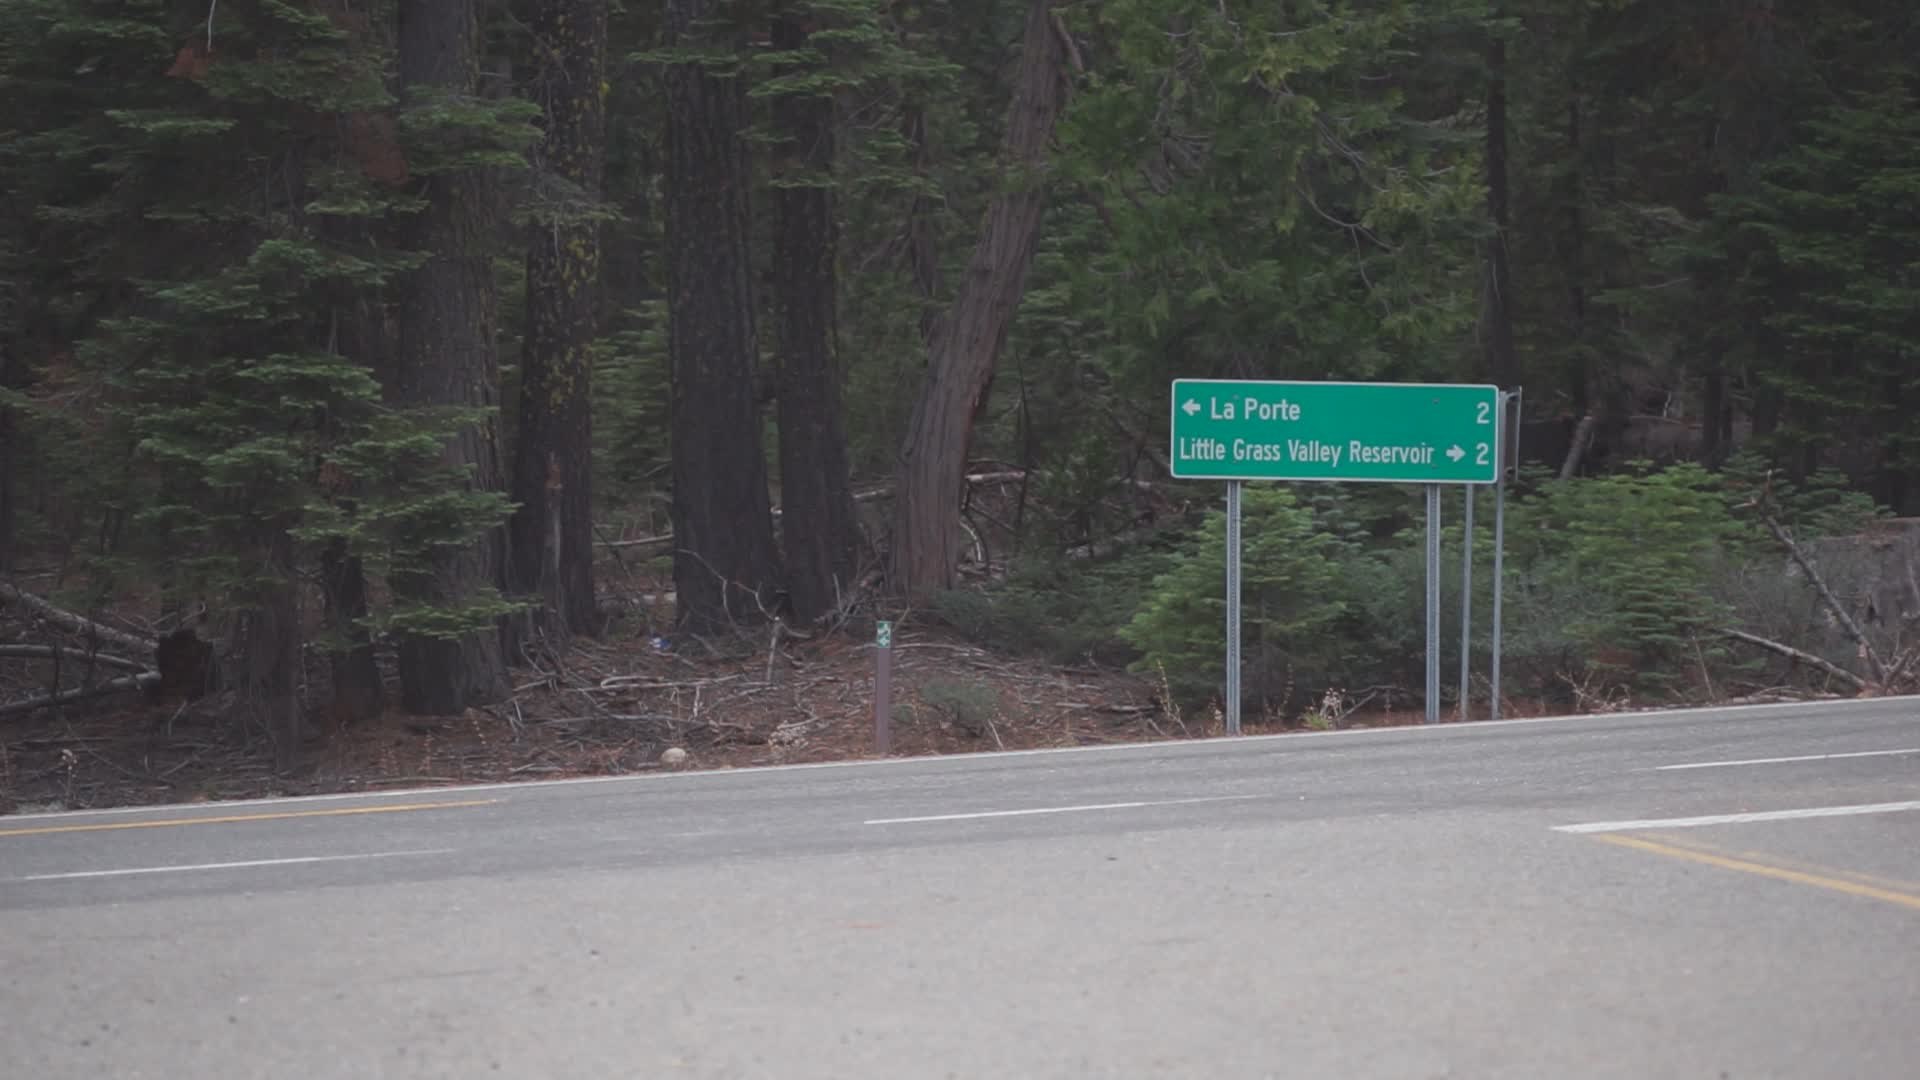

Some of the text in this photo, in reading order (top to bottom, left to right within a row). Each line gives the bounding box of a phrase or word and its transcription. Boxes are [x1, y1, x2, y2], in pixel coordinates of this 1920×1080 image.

[1211, 397, 1490, 424] La Porte 2
[1180, 438, 1489, 467] Little Grass Valley Reservoir 2
